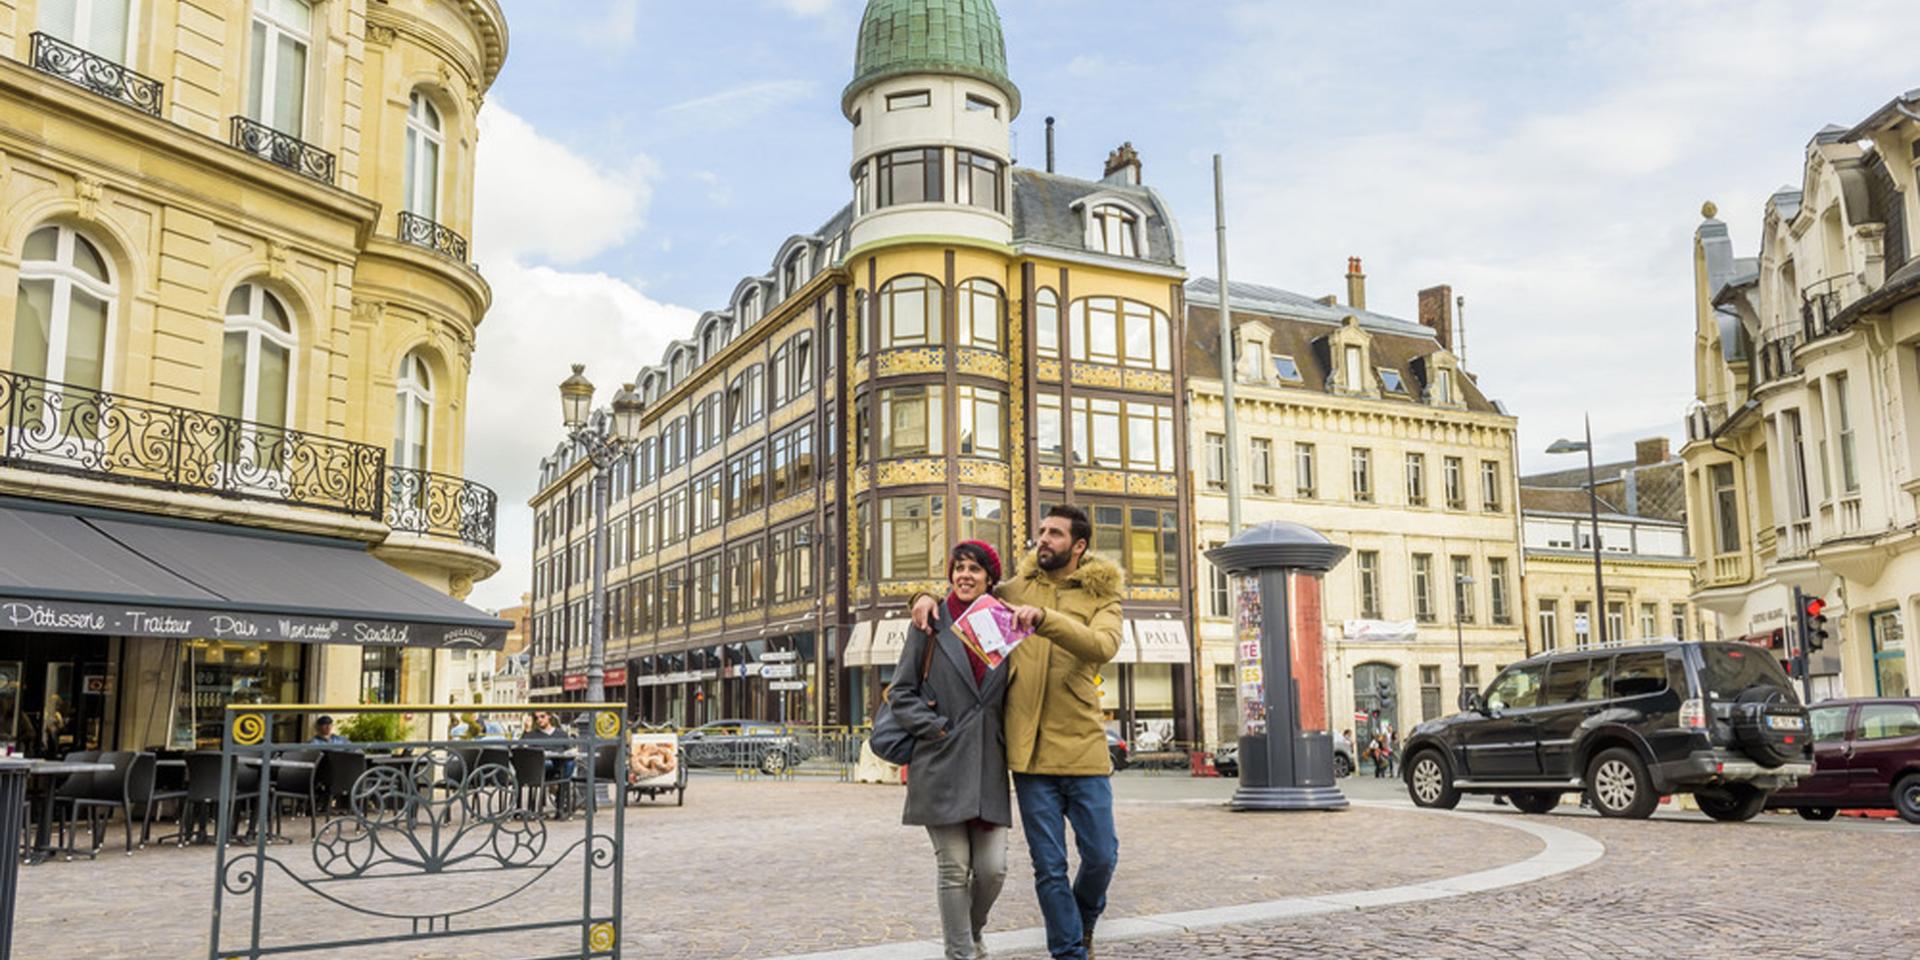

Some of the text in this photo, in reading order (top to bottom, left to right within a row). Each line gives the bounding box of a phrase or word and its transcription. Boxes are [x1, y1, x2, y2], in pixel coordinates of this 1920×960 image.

[3, 602, 105, 630] Pâtisserie
[126, 611, 192, 633] Traiteur
[209, 615, 258, 636] Pain
[1143, 631, 1180, 644] PAUL
